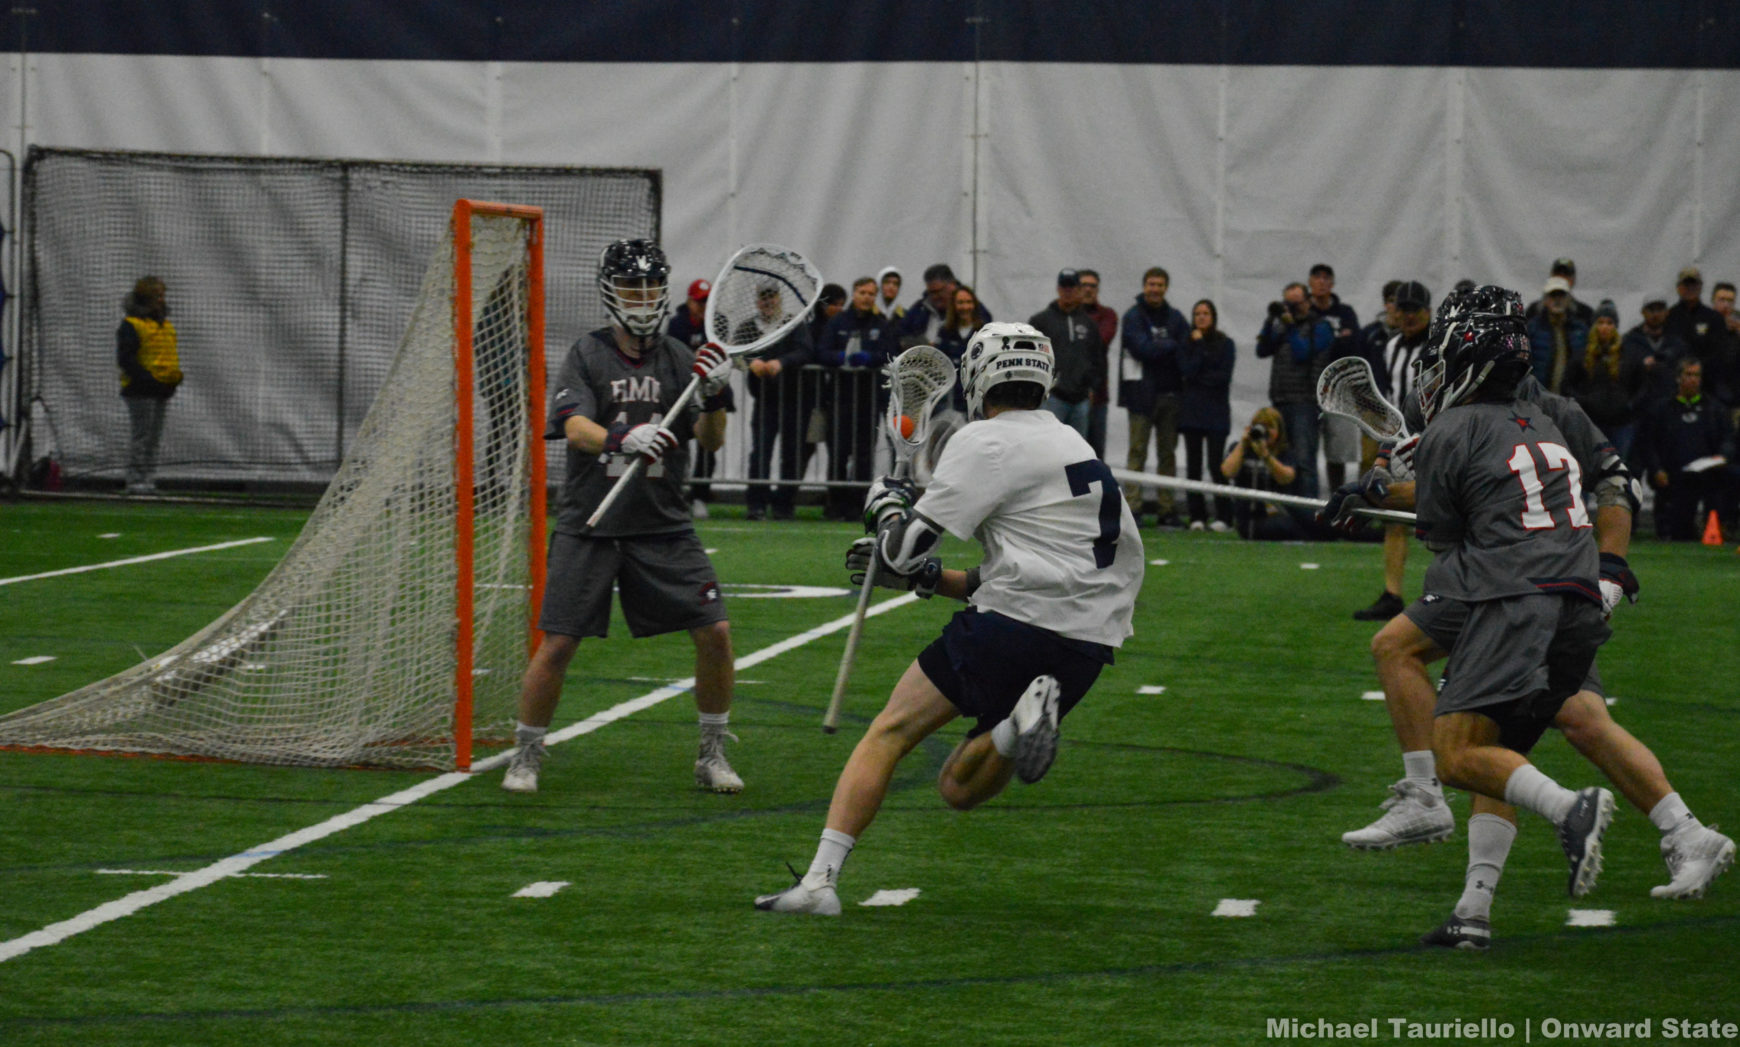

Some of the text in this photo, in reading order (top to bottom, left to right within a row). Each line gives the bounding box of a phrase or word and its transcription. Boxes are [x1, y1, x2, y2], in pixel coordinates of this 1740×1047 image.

[996, 358, 1023, 370] PENN
[1064, 459, 1122, 570] 7
[1507, 441, 1593, 531] 17
